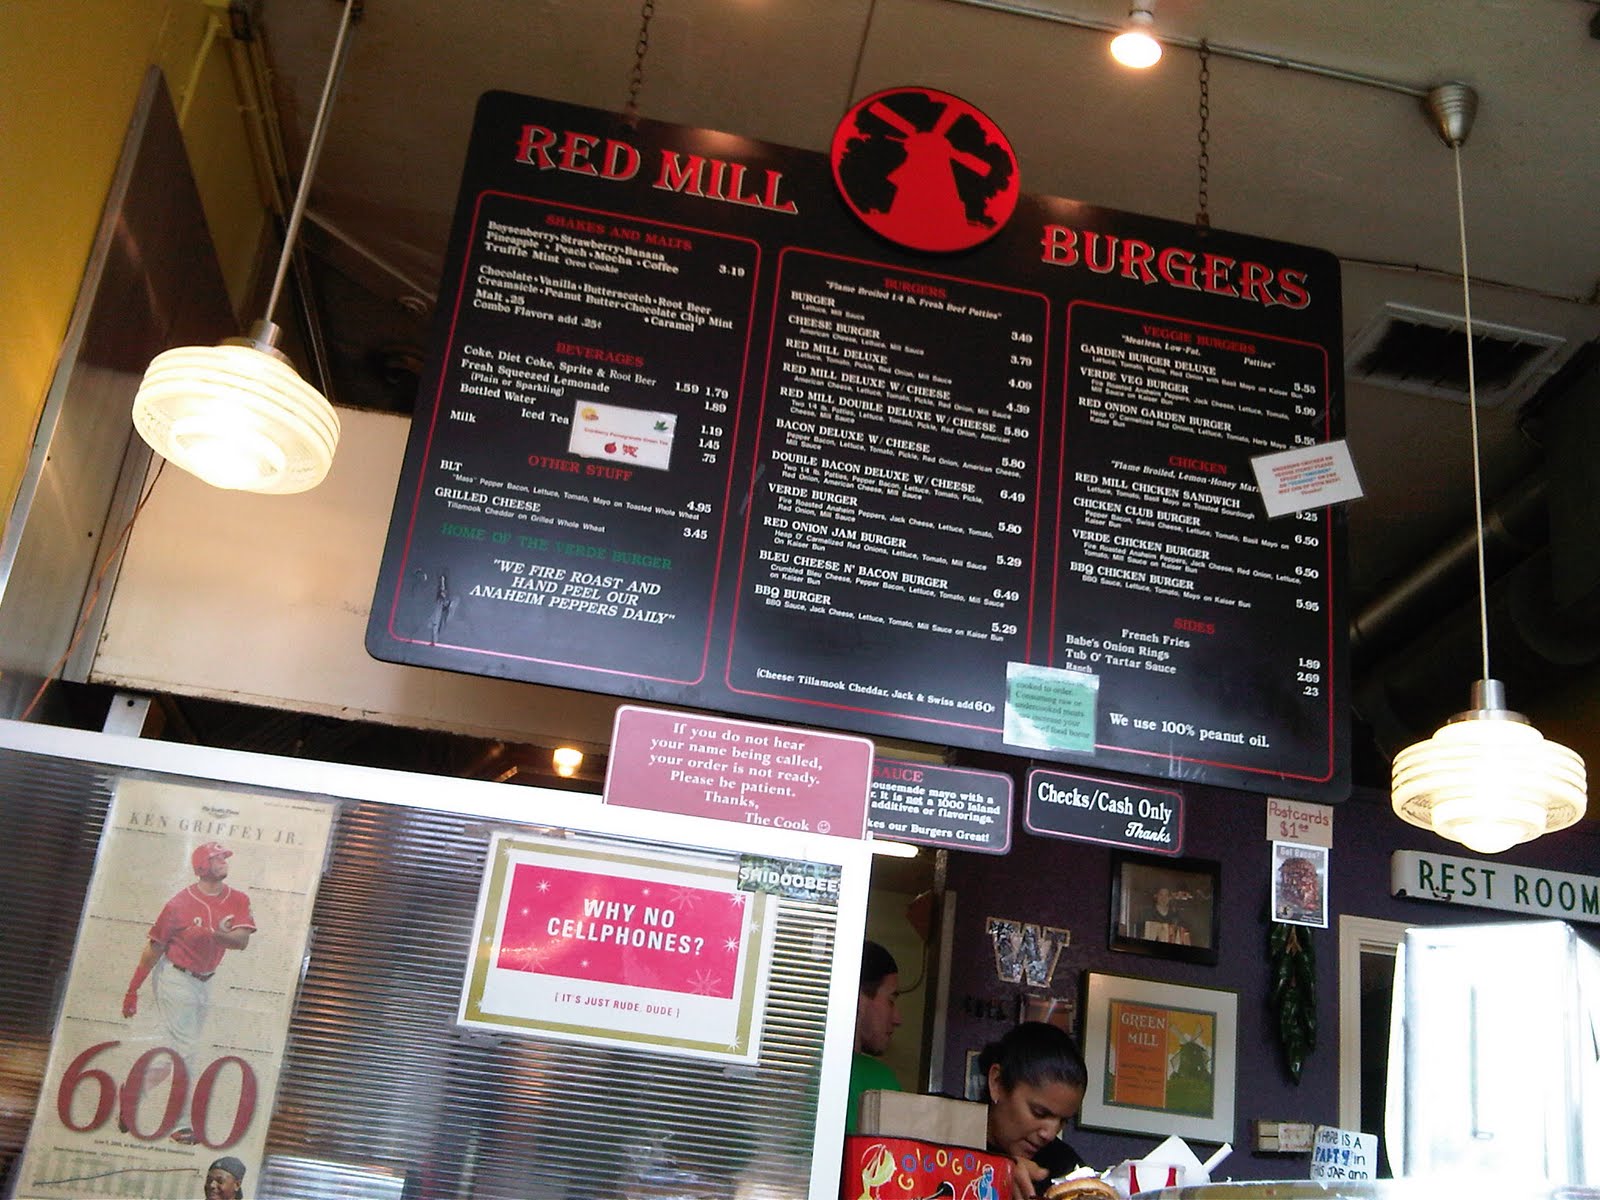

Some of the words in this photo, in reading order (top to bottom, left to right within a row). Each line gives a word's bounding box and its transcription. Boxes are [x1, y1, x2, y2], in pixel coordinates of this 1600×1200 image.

[515, 123, 641, 181] RED
[652, 149, 798, 215] MILL
[1040, 223, 1311, 310] BURGERS
[555, 342, 644, 366] BEVERAGES
[1080, 343, 1126, 360] GARDEN
[1128, 351, 1171, 368] BURGER
[1174, 360, 1217, 376] DELUXE
[461, 358, 494, 373] Fresh
[497, 365, 550, 383] Squeezed
[553, 374, 610, 393] Lemonade
[704, 400, 727, 413] 1.89
[450, 409, 476, 423] Milk
[460, 383, 501, 398] Bottled
[504, 390, 537, 405] Water
[701, 424, 723, 437] 1.19
[521, 407, 545, 421] Iced
[549, 412, 569, 425] Tea
[698, 438, 720, 451] 1.45
[527, 454, 580, 474] OTHER
[585, 463, 632, 481] STUFF
[1168, 455, 1227, 474] CHICKEN
[439, 459, 463, 472] BLT
[686, 500, 712, 514] 4.95
[1074, 471, 1099, 484] RED
[1101, 476, 1129, 490] MILL
[1131, 481, 1180, 498] CHICKEN
[1182, 490, 1240, 509] SANDWICH
[434, 486, 488, 504] GRILLED
[491, 496, 541, 513] CHEESE
[683, 527, 708, 540] 3.45
[447, 500, 482, 513] Tillamook
[484, 506, 515, 518] Cheddar
[530, 514, 555, 525] Grilled
[557, 518, 580, 529] Whole
[582, 522, 606, 533] Wheat
[768, 482, 808, 498] VERDE
[811, 489, 858, 507] BURGER
[997, 521, 1022, 535] 5.80
[763, 515, 789, 529] RED
[791, 520, 829, 535] ONION
[831, 527, 857, 540] JAM
[860, 531, 907, 549] BURGER
[996, 554, 1022, 568] 5.29
[1072, 528, 1111, 544] VERDE
[1113, 535, 1163, 552] CHICKEN
[1165, 543, 1210, 560] BURGER
[1294, 566, 1320, 579] 6.50
[493, 558, 526, 575] "WE
[528, 564, 567, 581] FIRE
[569, 571, 624, 590] ROAST
[625, 580, 662, 596] AND
[511, 576, 558, 594] HAND
[561, 583, 601, 601] PEEL
[606, 591, 640, 607] OUR
[469, 584, 546, 606] ANAHEIM
[547, 595, 619, 617] PEPPERS
[621, 607, 676, 625] DAILY"
[754, 583, 780, 599] BBQ
[783, 588, 831, 606] BURGER
[991, 622, 1018, 635] 5.29
[1174, 617, 1215, 635] SIDES
[1064, 647, 1088, 661] Tub
[1104, 654, 1142, 669] Tartar
[1144, 660, 1177, 675] Sauce
[1065, 634, 1100, 649] Babe's
[1102, 640, 1135, 654] Onion
[1138, 645, 1170, 662] Rings
[1296, 671, 1320, 684] 2.69
[1121, 628, 1160, 644] French
[1162, 635, 1191, 649] Fries
[1298, 657, 1321, 670] 1.89
[797, 674, 846, 691] Tillamook
[848, 682, 890, 698] Cheddar,
[890, 689, 914, 701] Jack
[927, 694, 955, 707] Swiss
[673, 722, 687, 734] If
[689, 728, 716, 740] you
[721, 729, 740, 742] do
[745, 736, 768, 746] not
[774, 736, 805, 751] hear
[1109, 712, 1129, 727] We
[1133, 718, 1157, 731] use
[1161, 720, 1196, 737] 100%
[1199, 728, 1245, 744] peanut
[1248, 734, 1270, 748] oil.
[649, 754, 683, 766] your
[687, 759, 728, 771] order
[733, 762, 744, 774] is
[749, 767, 772, 778] not
[777, 771, 820, 787] ready.
[650, 738, 684, 750] your
[689, 744, 727, 756] name
[732, 746, 771, 766] being
[776, 754, 822, 771] called,
[670, 770, 714, 786] Please
[719, 776, 736, 789] be
[740, 782, 795, 797] patient.
[704, 790, 759, 810] Thanks,
[872, 782, 926, 795] ousemade
[928, 789, 957, 799] mayo
[960, 792, 984, 803] with
[871, 800, 922, 814] additives
[922, 808, 935, 816] or
[938, 808, 994, 825] flavorings.
[880, 791, 889, 800] It
[892, 792, 903, 802] is
[905, 796, 923, 805] not
[937, 798, 965, 810] 1000
[967, 802, 1000, 815] Island
[1038, 782, 1133, 815] Checks/Cash
[1138, 799, 1172, 825] Only
[1269, 801, 1329, 826] Postcards
[130, 812, 168, 827] KEN
[179, 818, 265, 841] GRIFFEY
[274, 830, 303, 846] JR.
[745, 812, 770, 825] The
[773, 816, 809, 831] Cook
[888, 823, 908, 832] our
[911, 824, 953, 838] Burgers
[956, 830, 990, 842] Great!
[1125, 822, 1171, 843] Thanks
[1419, 859, 1495, 900] REST
[1514, 874, 1600, 915] ROOM
[582, 898, 636, 922] WHY
[644, 907, 675, 928] NO
[547, 917, 704, 955] CELLPHONES?
[585, 996, 610, 1007] JUST
[646, 1004, 673, 1016] DUDE
[1121, 1012, 1167, 1030] GREEN
[1127, 1032, 1159, 1047] MILL
[57, 1040, 259, 1150] 600
[1342, 1134, 1350, 1146] IS
[1354, 1137, 1362, 1149] A
[1327, 1166, 1345, 1178] JAR
